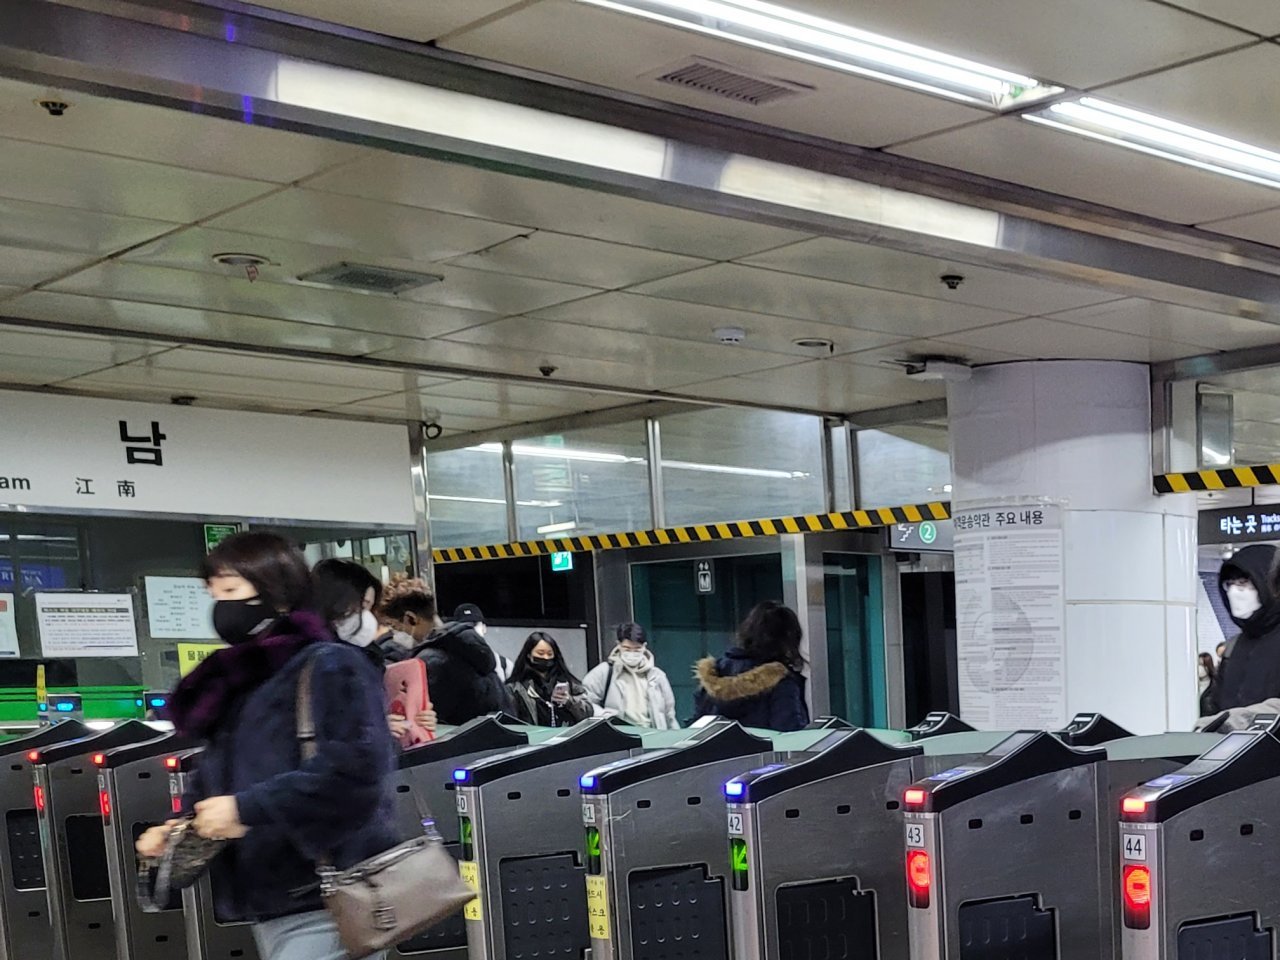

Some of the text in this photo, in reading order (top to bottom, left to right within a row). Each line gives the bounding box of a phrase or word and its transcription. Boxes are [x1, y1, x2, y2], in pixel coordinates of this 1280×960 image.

[118, 420, 167, 467] 남
[0, 476, 31, 491] am
[995, 512, 1017, 528] 주요
[1019, 510, 1044, 526] 내용
[1220, 515, 1243, 535] 타는
[1245, 514, 1258, 534] 곳
[729, 816, 741, 832] 42
[907, 827, 921, 844] 43
[1125, 838, 1142, 856] 44
